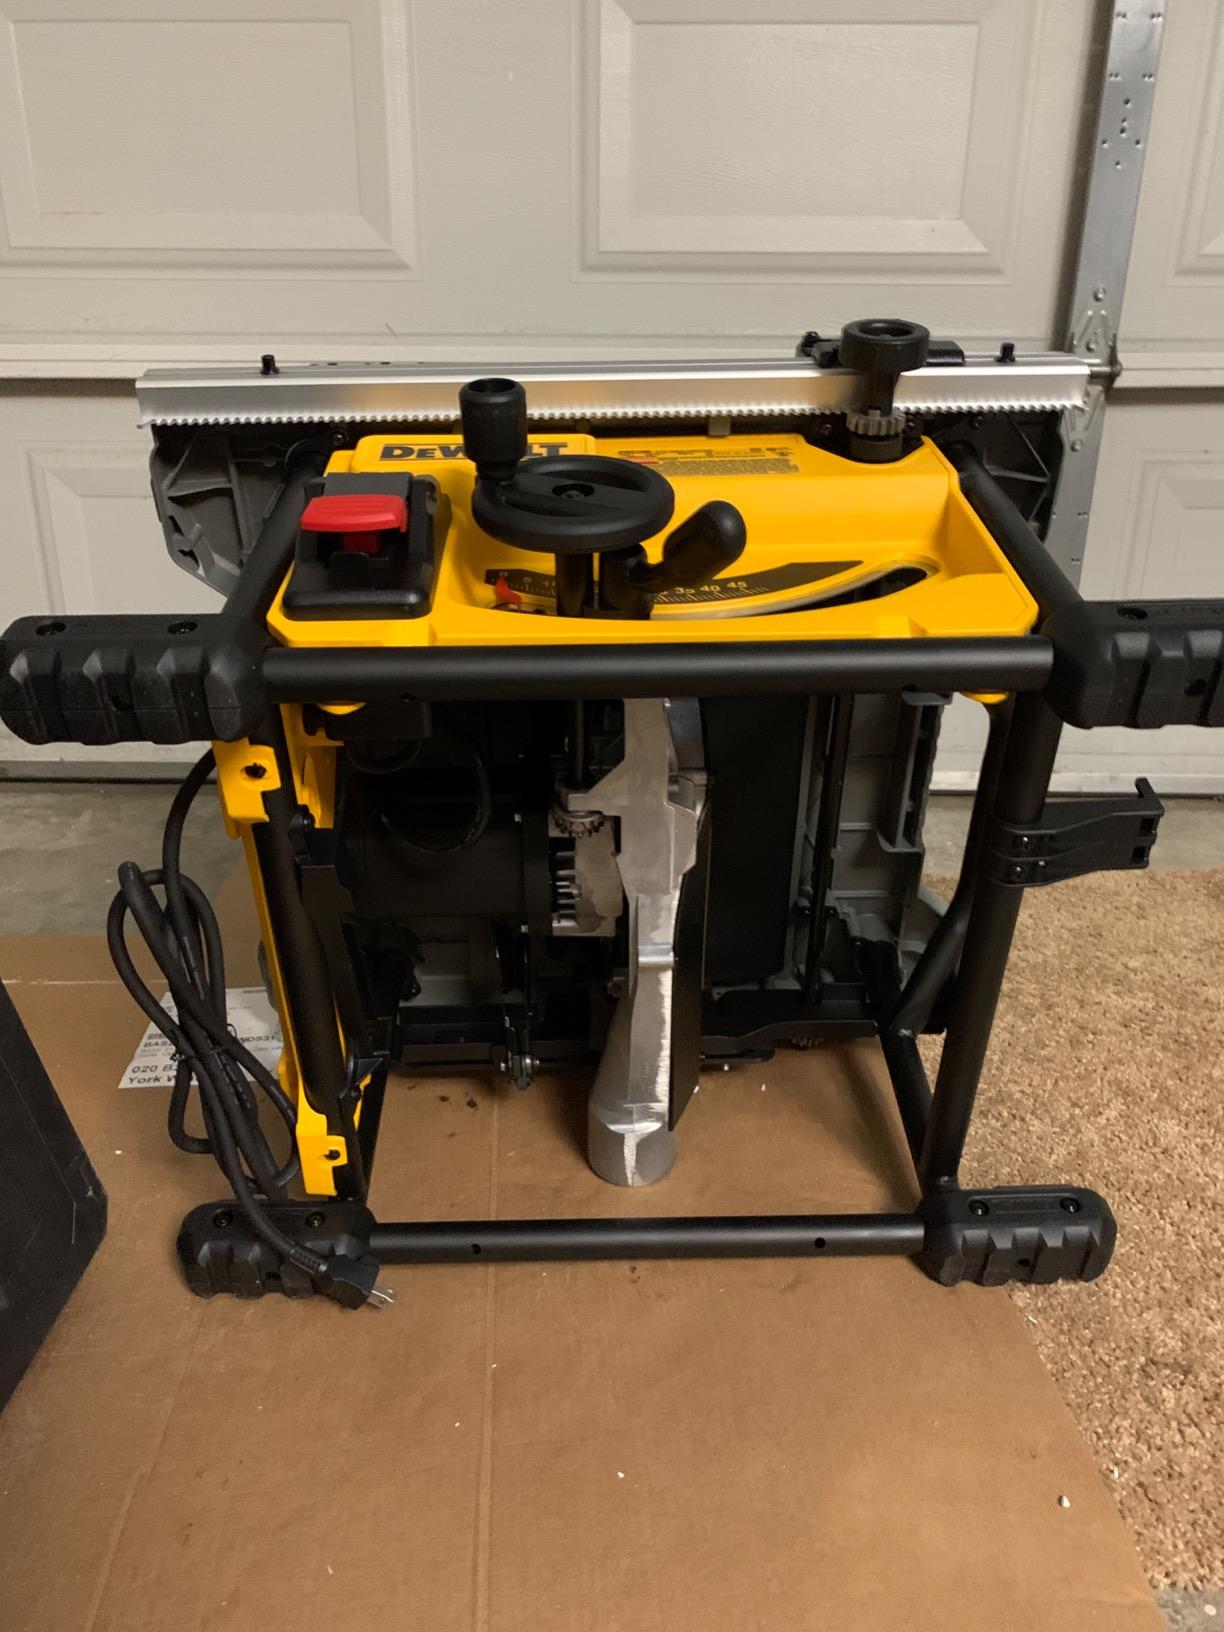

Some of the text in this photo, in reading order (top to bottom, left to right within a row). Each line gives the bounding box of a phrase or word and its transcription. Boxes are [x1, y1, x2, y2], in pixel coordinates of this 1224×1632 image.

[380, 445, 567, 459] DEWLT
[131, 1064, 158, 1074] 020
[128, 1075, 162, 1084] York
